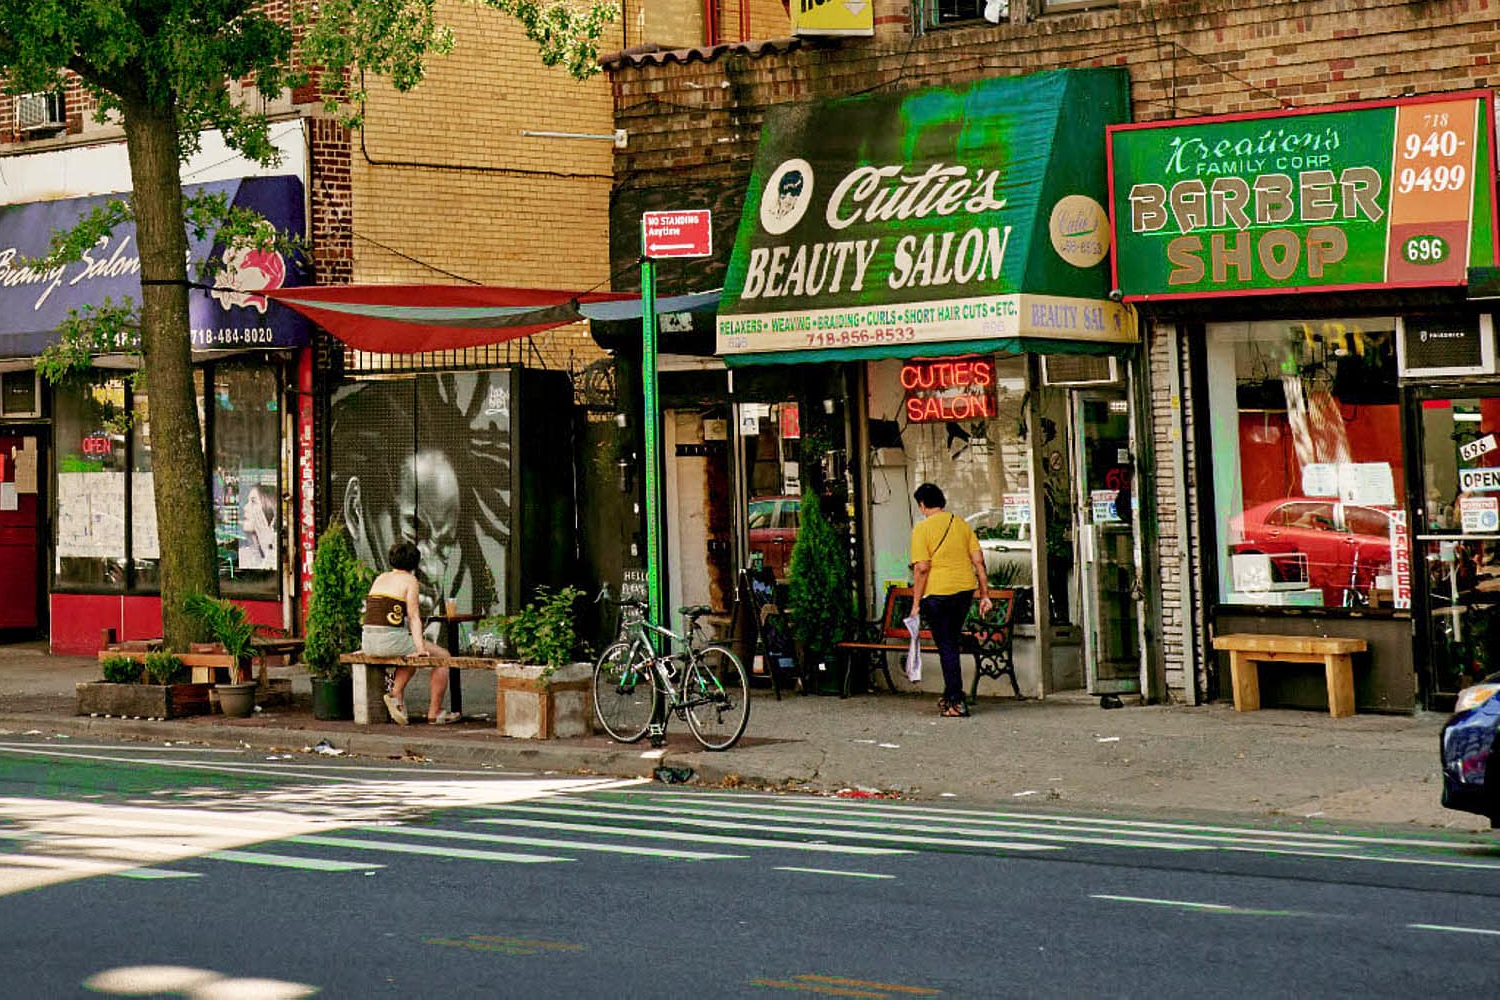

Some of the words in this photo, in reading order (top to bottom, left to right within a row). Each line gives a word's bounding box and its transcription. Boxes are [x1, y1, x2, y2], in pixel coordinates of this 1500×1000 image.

[1424, 113, 1448, 128] 718
[1196, 159, 1265, 175] FAMILY
[1277, 155, 1331, 169] CORP.
[1399, 165, 1465, 193] 9499
[826, 163, 1006, 230] Cutie's
[1129, 166, 1384, 235] BARBER
[648, 217, 659, 226] NO
[661, 215, 700, 225] STANDING
[70, 235, 140, 286] Salon
[1168, 226, 1348, 285] SHOP
[1408, 239, 1441, 260] 696
[741, 239, 880, 300] BEAUTY
[889, 226, 1012, 290] SALON
[720, 319, 762, 335] RELAXERS
[772, 316, 810, 332] WEAVING
[818, 313, 859, 329] BRAIDING
[867, 311, 896, 326] CURLS
[905, 307, 936, 323] SHORT
[938, 305, 961, 320] HAIR
[963, 302, 989, 319] CUTS
[996, 300, 1017, 317] ETC.
[1032, 304, 1078, 329] BEAUTY
[190, 327, 273, 345] 718-484-8020
[806, 327, 915, 346] 718-856-8533
[901, 362, 990, 388] CUTIE'S
[907, 395, 988, 421] SALON
[82, 438, 111, 454] OPEN
[1463, 440, 1487, 458] 696
[1463, 471, 1500, 488] OPEN
[1395, 525, 1411, 599] BARBER
